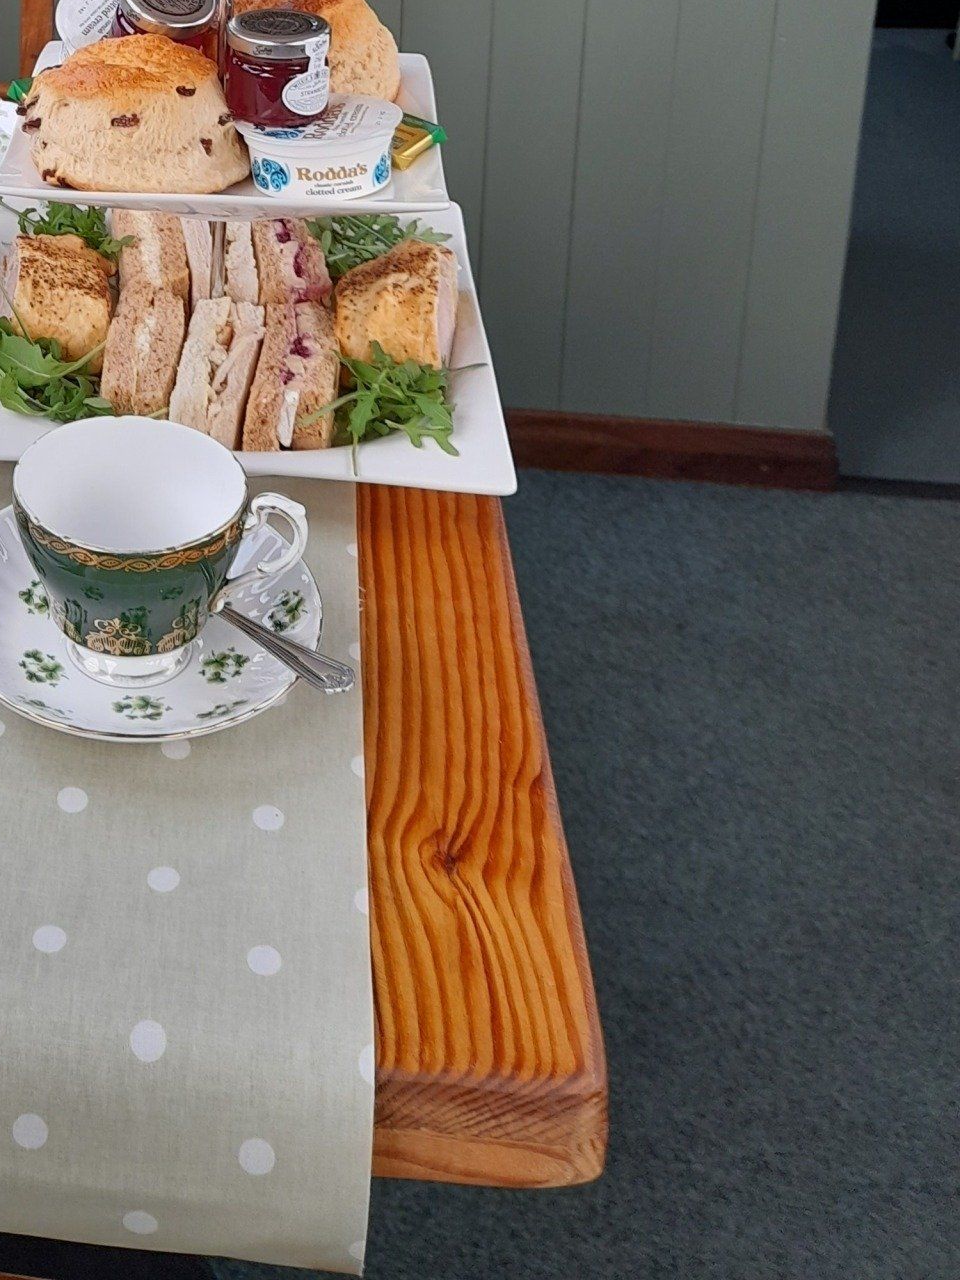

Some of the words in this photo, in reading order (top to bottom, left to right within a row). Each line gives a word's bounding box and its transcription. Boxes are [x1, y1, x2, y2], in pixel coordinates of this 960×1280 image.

[295, 162, 368, 182] Rodda's
[305, 185, 335, 196] clotted
[336, 184, 363, 195] cream
